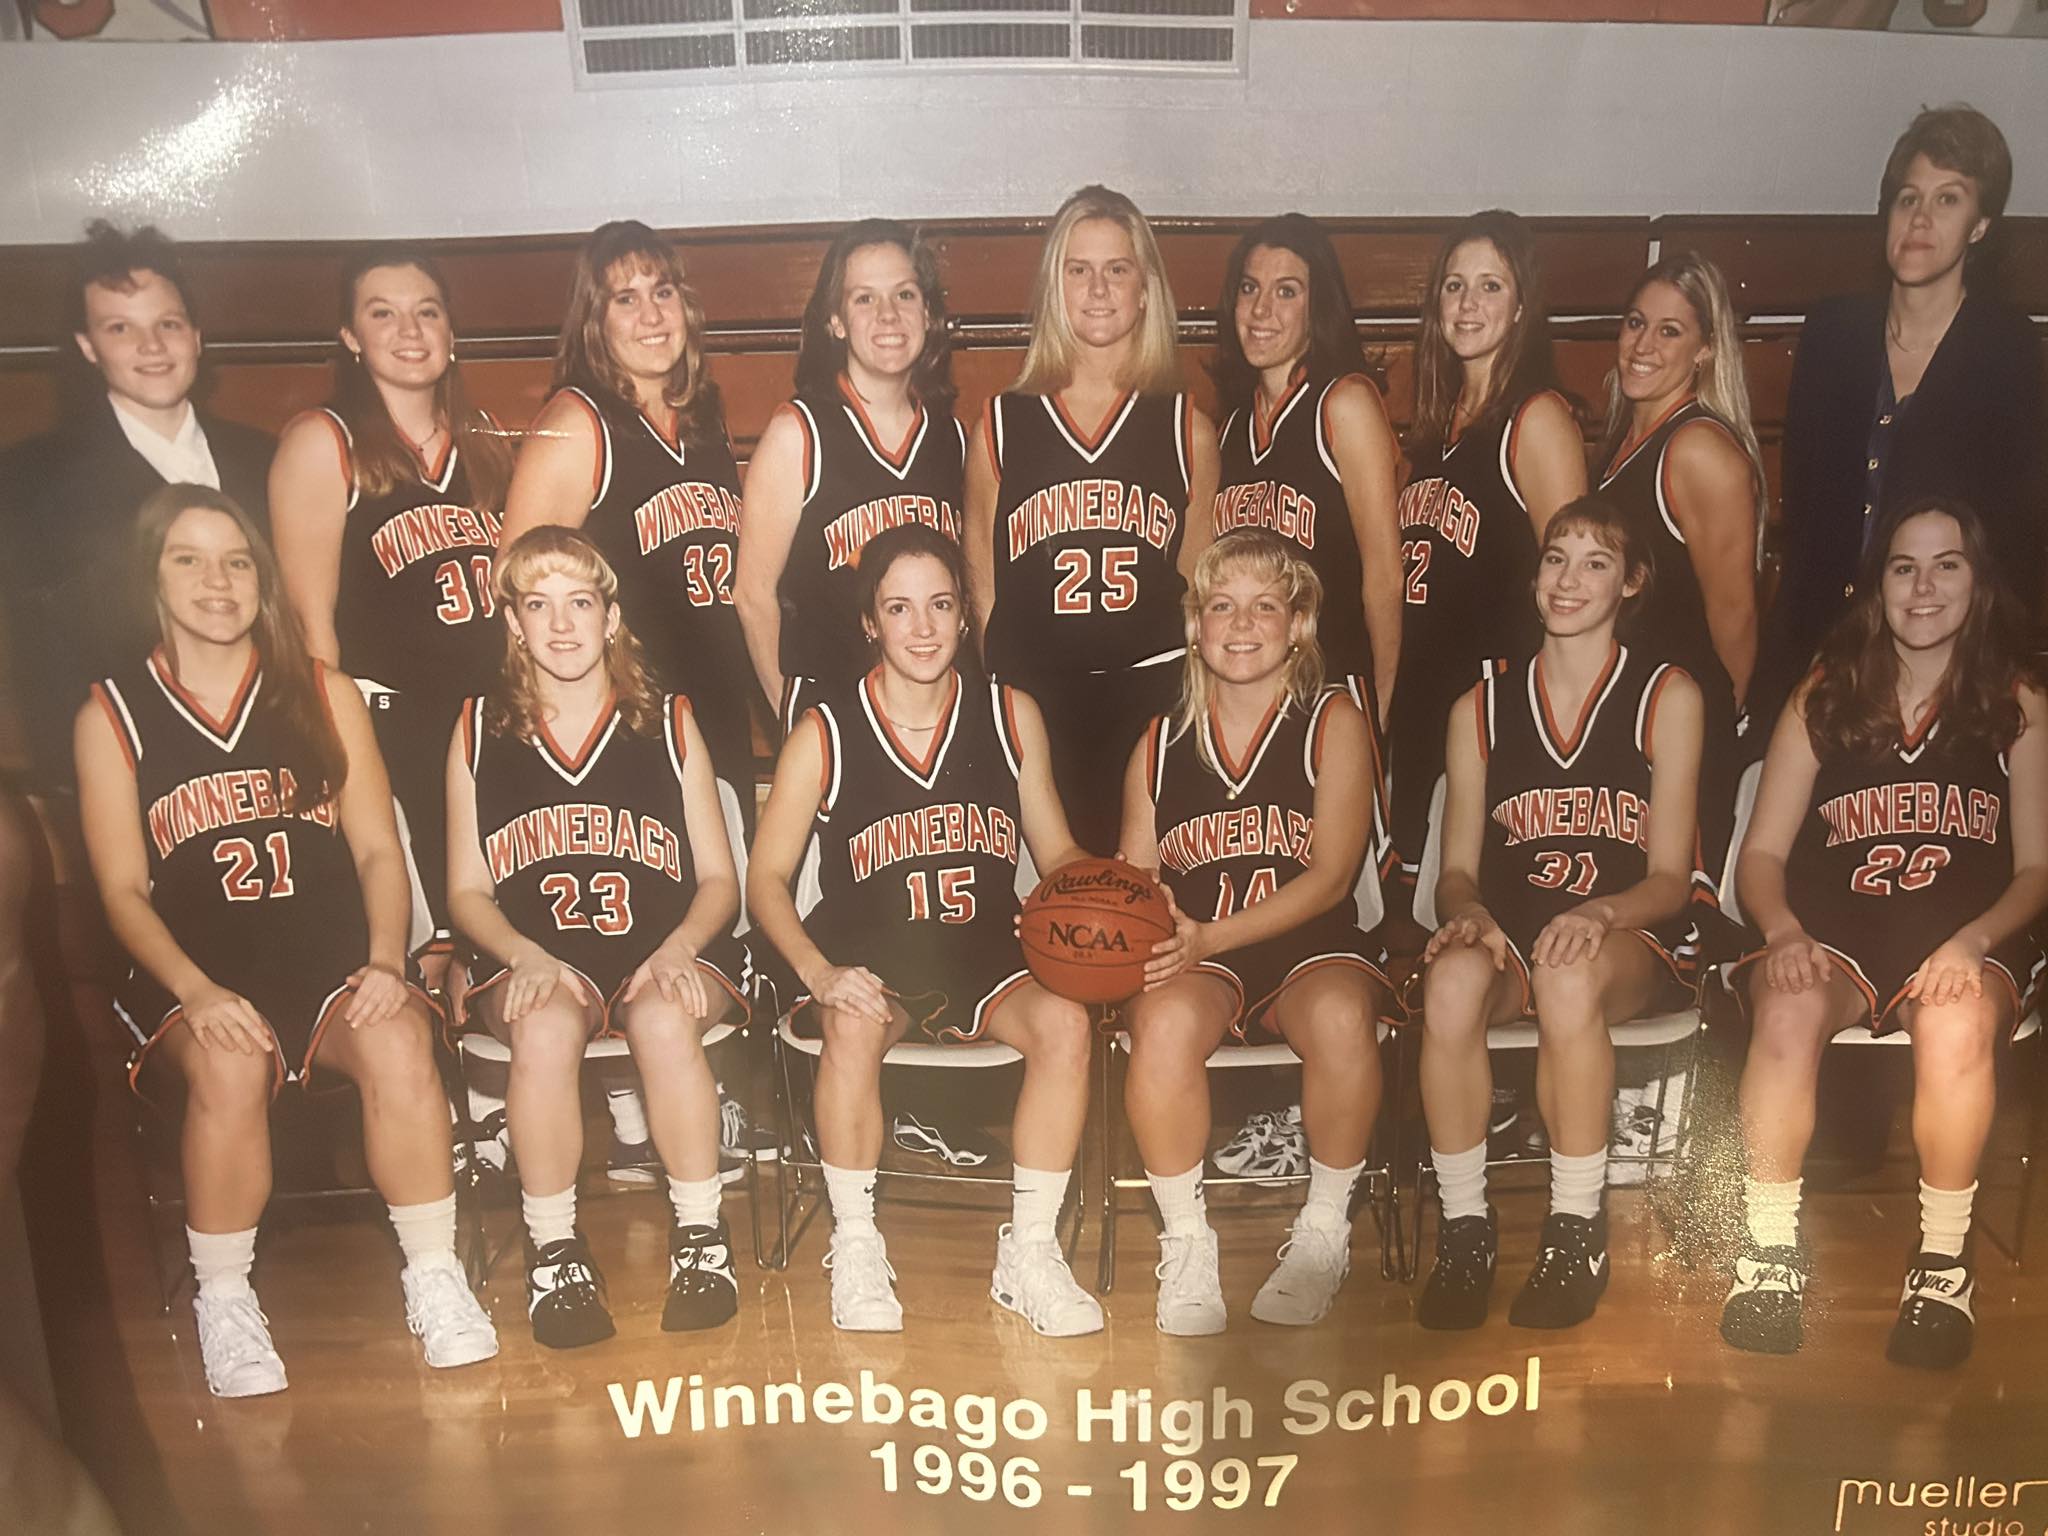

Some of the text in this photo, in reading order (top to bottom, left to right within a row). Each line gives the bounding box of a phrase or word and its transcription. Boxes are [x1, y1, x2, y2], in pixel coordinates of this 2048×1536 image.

[371, 504, 504, 579] WINNEBA
[635, 482, 742, 556] WINNEBA
[823, 495, 961, 571] WINNEBA
[1213, 480, 1316, 550] NNEBAGO
[684, 543, 734, 607] 32
[1053, 546, 1138, 614] 25
[378, 695, 391, 710] S
[486, 803, 681, 884] WINNEBAGO
[849, 803, 1017, 883] WINNEBAGO
[1818, 782, 2000, 848] WINNEBAGO
[213, 831, 294, 901] 21
[906, 866, 976, 923] 15
[1040, 869, 1152, 905] Rawlings
[1527, 851, 1598, 896] 31
[1851, 844, 1951, 896] 20
[540, 872, 633, 936] 23
[1047, 921, 1130, 953] NCAA
